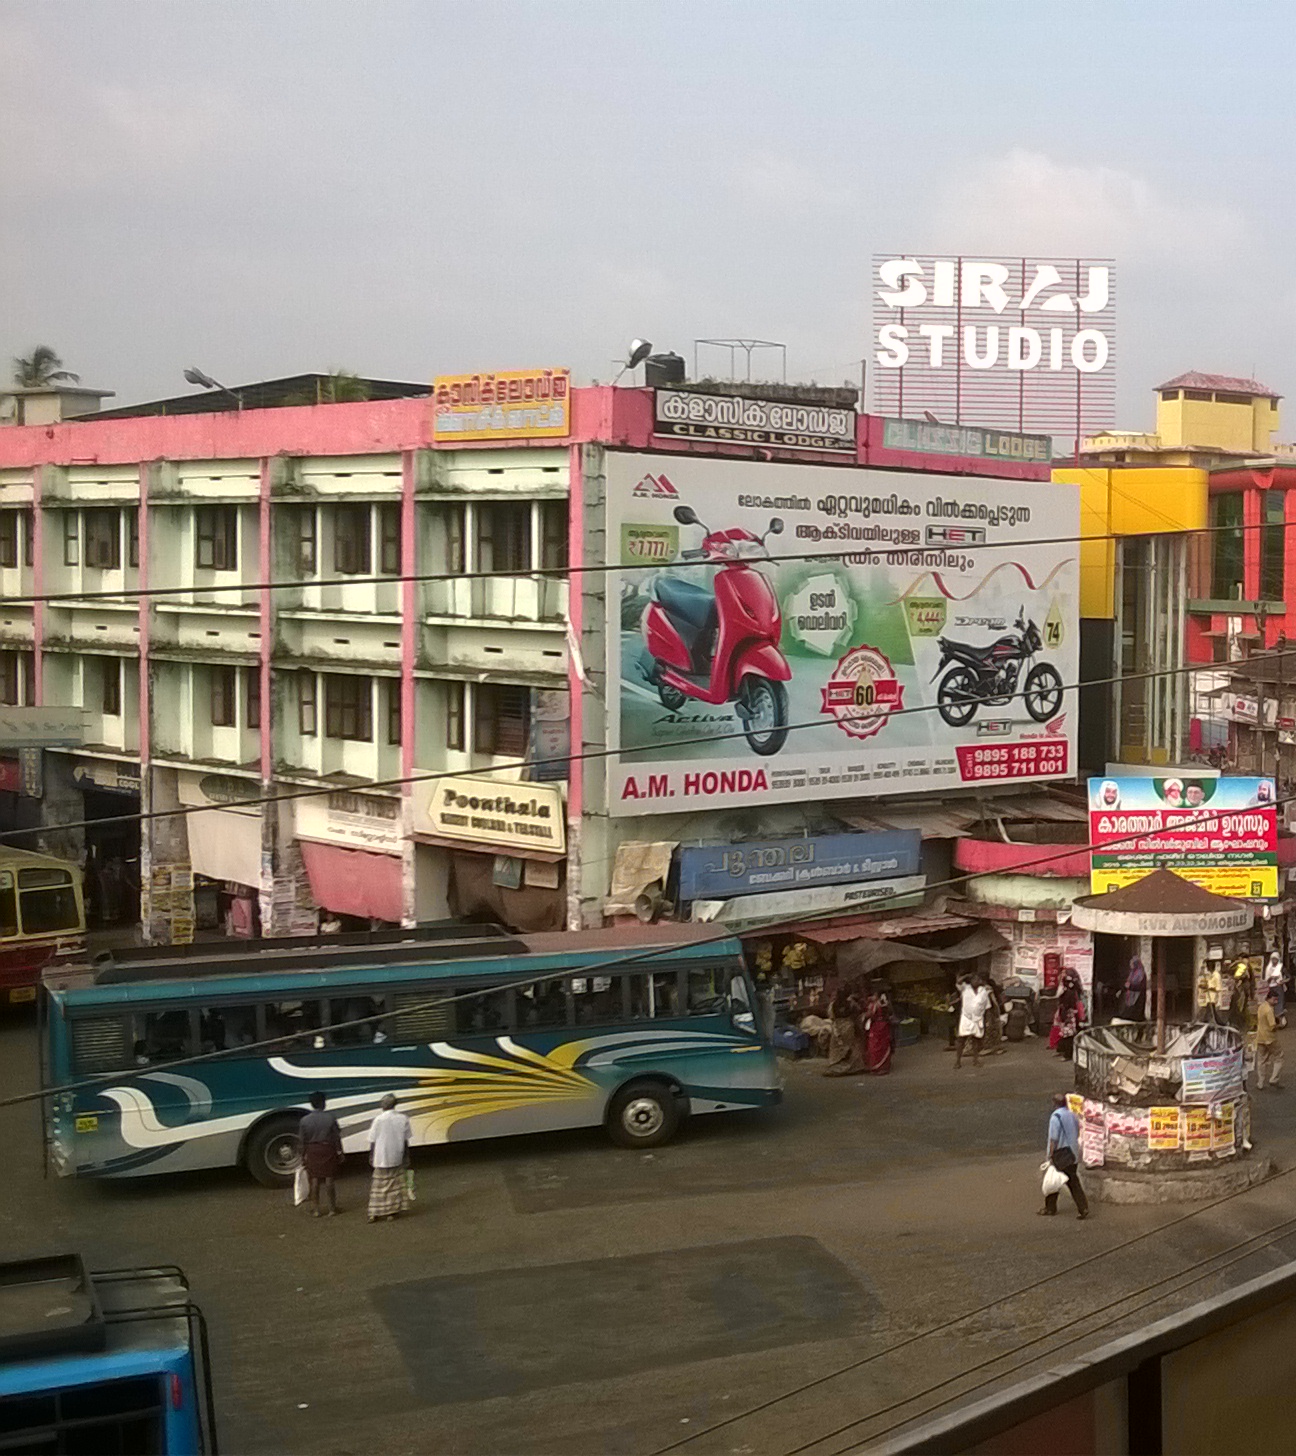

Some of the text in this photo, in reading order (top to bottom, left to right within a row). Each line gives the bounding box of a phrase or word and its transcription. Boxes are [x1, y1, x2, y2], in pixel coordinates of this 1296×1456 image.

[877, 258, 1109, 314] SIRAJ
[877, 324, 1109, 373] STUDIO
[769, 406, 850, 436] ലോഡ്ജ്
[672, 423, 767, 442] CLASSIC
[984, 433, 1048, 460] LODGE
[738, 493, 1032, 527] ലോകത്തിൽ ഏറ്റവുമധികം വിൽക്കപ്പെടുന്ന
[795, 521, 986, 546] ആക്ടിവയിലുള്ള HET
[809, 589, 836, 611] ഉടൻ
[1046, 621, 1060, 642] 74
[855, 685, 874, 706] 60
[652, 713, 735, 724] Activa
[978, 721, 1011, 733] HET
[965, 753, 974, 777] Call
[974, 745, 1065, 763] 9895 188 733
[974, 763, 1009, 778] 9895
[1011, 761, 1036, 775] 711
[1039, 760, 1064, 773] 001
[621, 774, 675, 800] A.M.
[683, 769, 769, 796] HONDA
[1221, 814, 1270, 837] ഉറൂസും
[1138, 912, 1248, 931] KVR AUTOMOBILES
